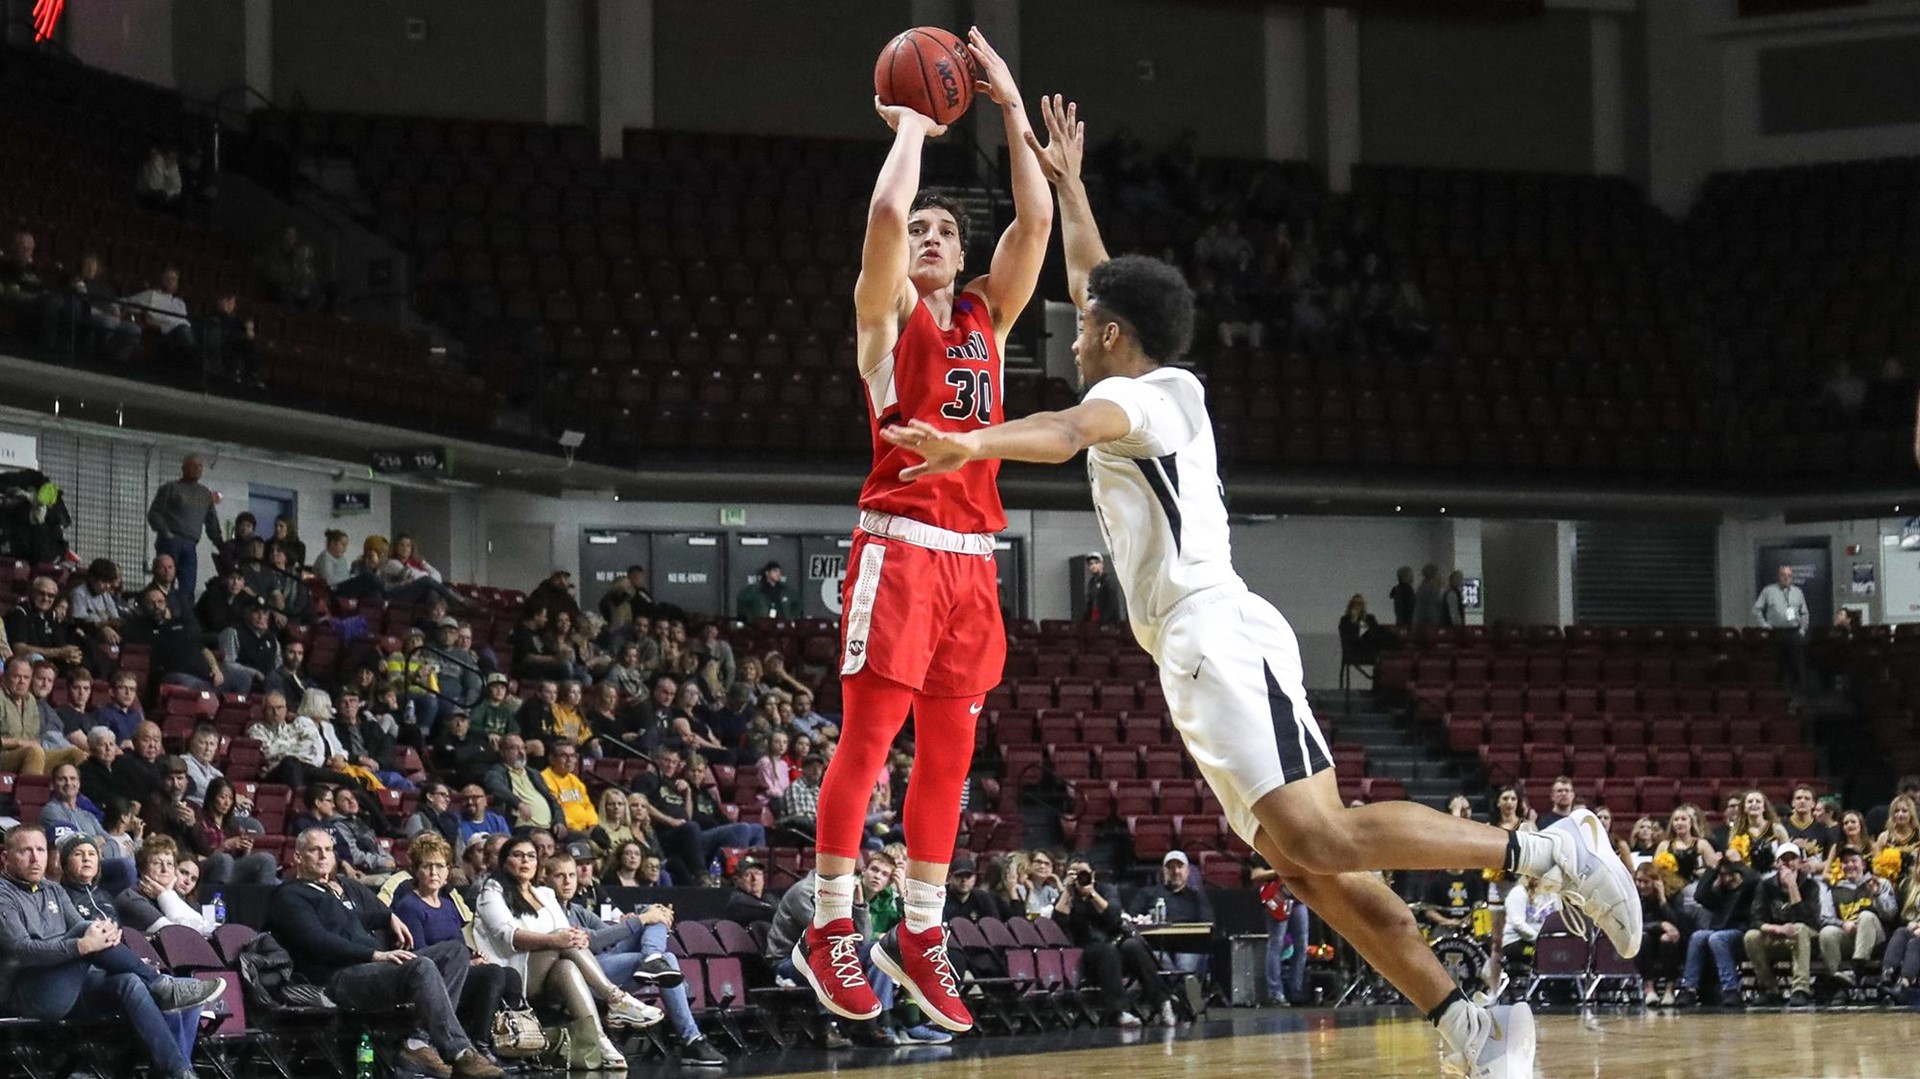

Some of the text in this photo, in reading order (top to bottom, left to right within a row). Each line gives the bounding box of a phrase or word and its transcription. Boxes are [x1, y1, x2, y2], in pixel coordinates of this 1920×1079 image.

[935, 58, 960, 109] NCAA
[940, 368, 993, 424] 30
[667, 573, 707, 583] NO RE-ENTRY
[811, 557, 842, 578] EXIT
